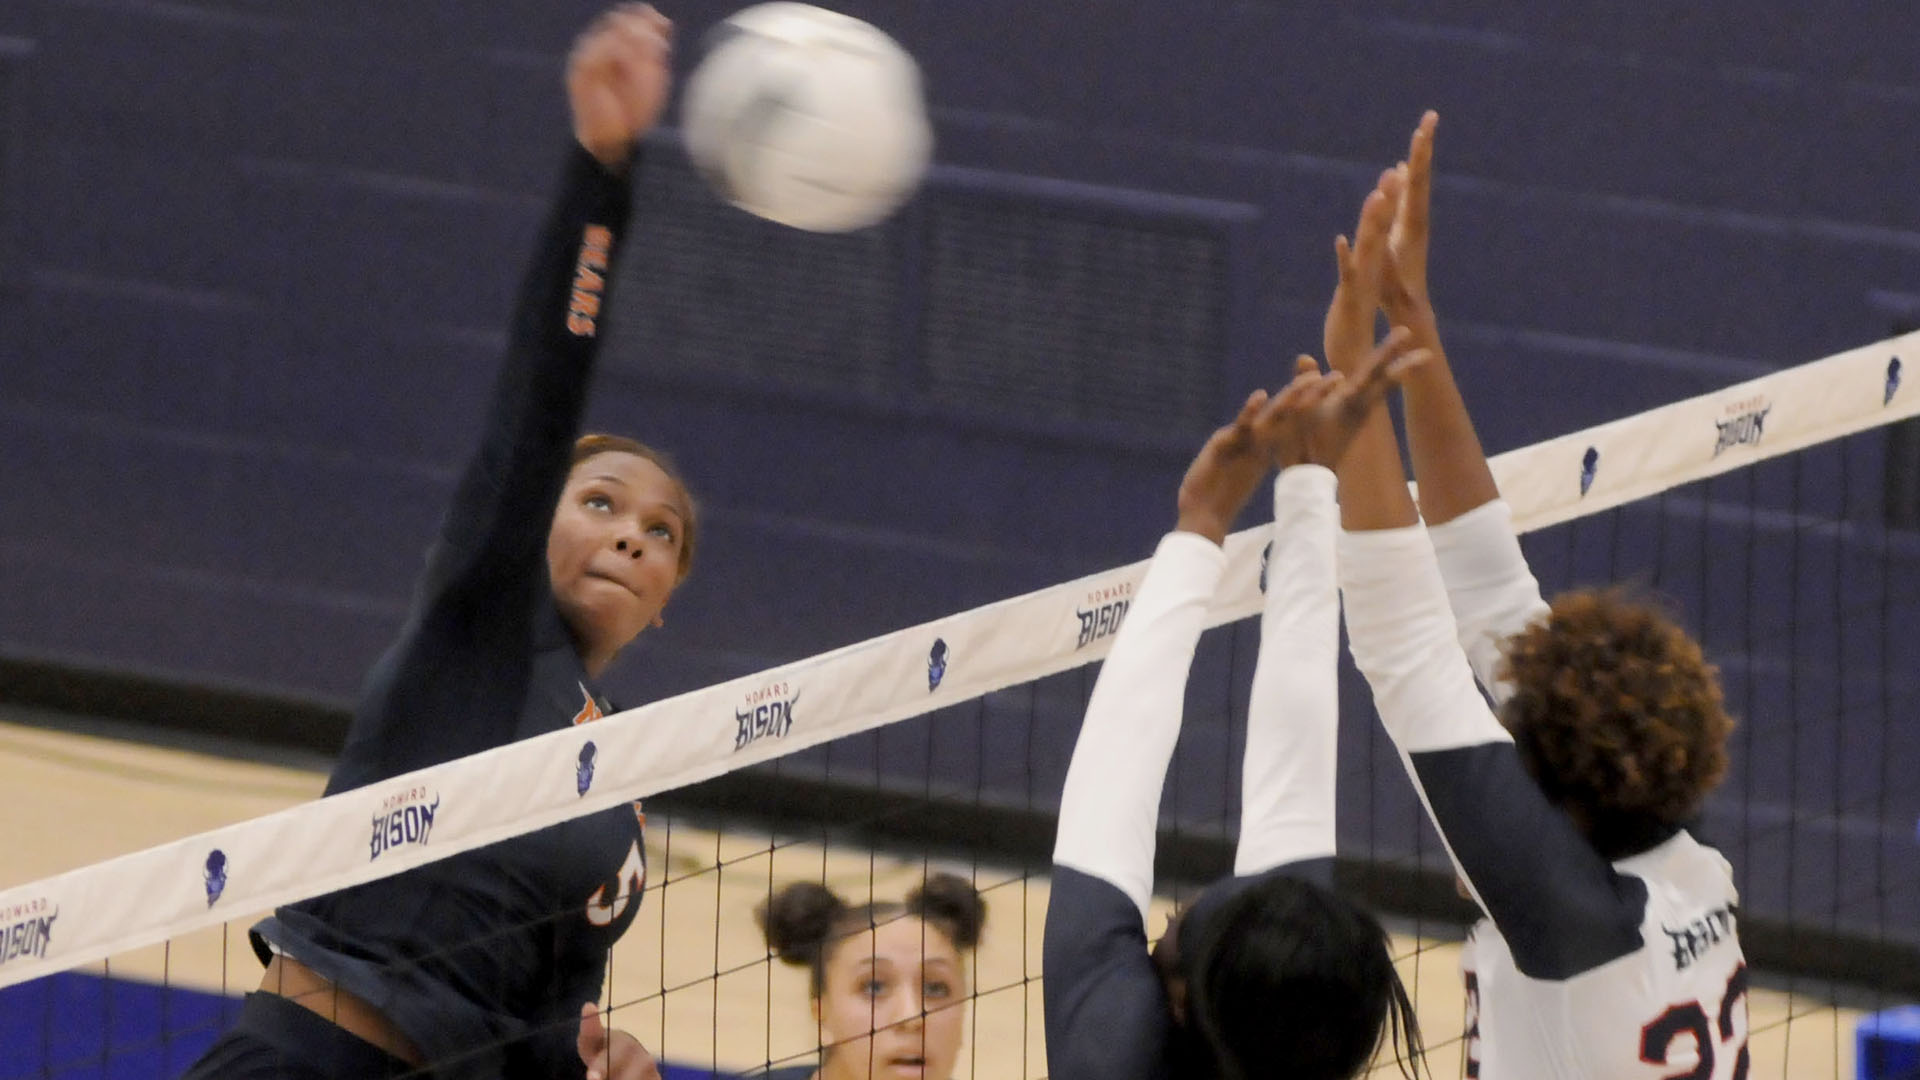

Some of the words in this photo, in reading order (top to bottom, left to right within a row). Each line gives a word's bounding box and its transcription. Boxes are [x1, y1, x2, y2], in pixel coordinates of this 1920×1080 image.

[1087, 582, 1131, 604] HOWARD
[745, 682, 789, 705] HOWARD
[734, 688, 800, 752] BISON
[383, 786, 426, 809] HOWARD
[370, 791, 440, 861] BISON
